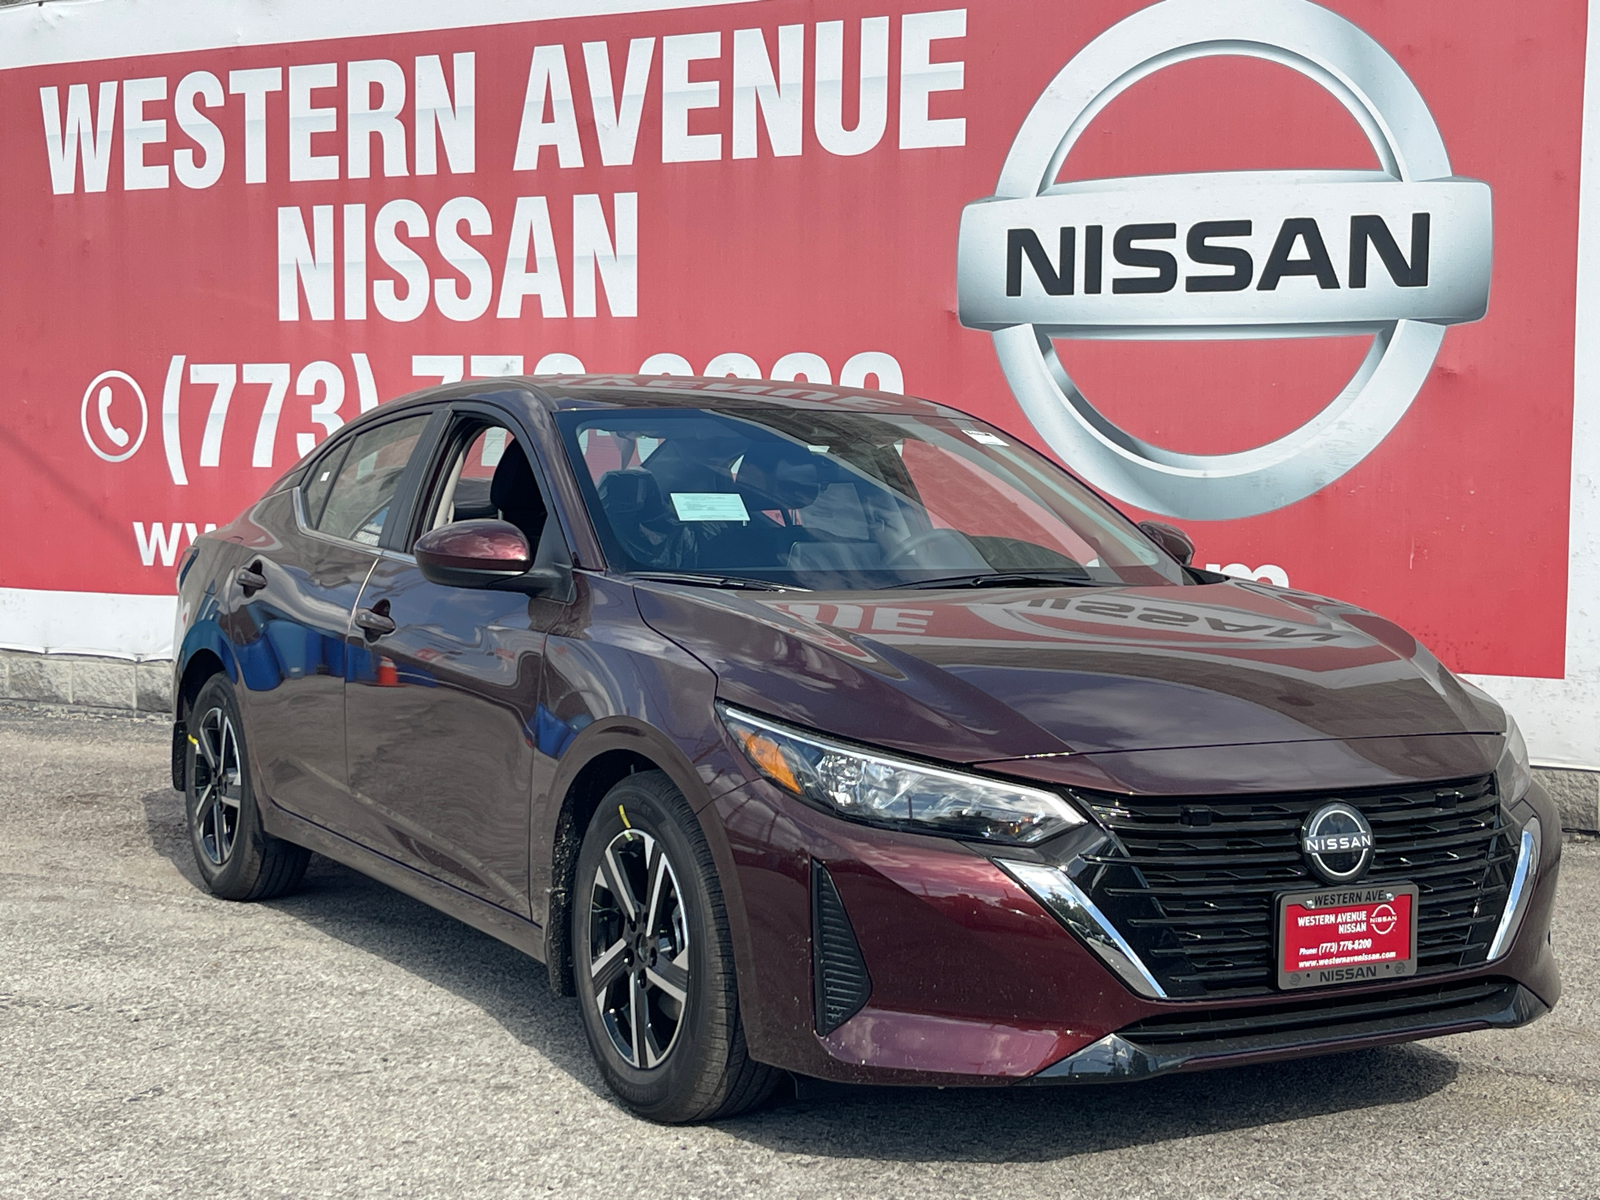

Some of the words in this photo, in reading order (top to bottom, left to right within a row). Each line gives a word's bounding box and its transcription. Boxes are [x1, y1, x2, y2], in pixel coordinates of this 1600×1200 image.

[40, 51, 476, 195] WESTERN
[513, 8, 967, 171] AVENUE
[278, 192, 638, 322] NISSAN
[1006, 212, 1430, 297] NISSAN
[1306, 834, 1371, 851] NISSAN
[1314, 892, 1363, 906] WESTERN
[1297, 914, 1335, 927] WESTERN
[1336, 911, 1367, 924] AVENUE
[1370, 915, 1397, 923] NISSAN
[1338, 922, 1367, 934] NISSAN
[1318, 942, 1338, 956] (773)
[1320, 965, 1376, 982] NISSAN
